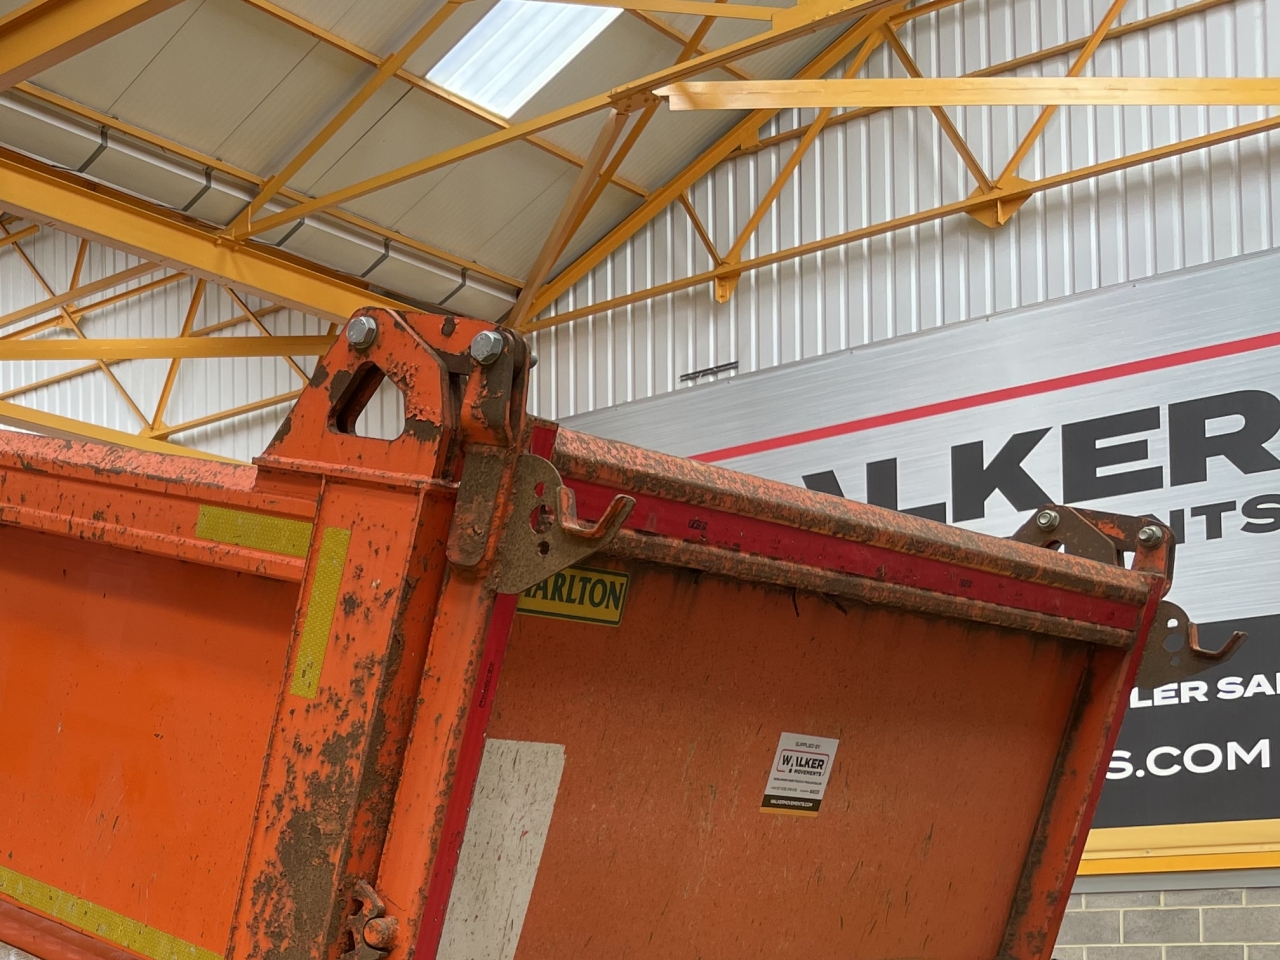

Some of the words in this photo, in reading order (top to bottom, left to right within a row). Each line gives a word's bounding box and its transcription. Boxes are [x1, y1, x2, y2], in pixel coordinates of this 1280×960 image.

[1216, 671, 1280, 700] SA
[794, 768, 822, 777] MOVEMENTS
[1105, 738, 1271, 780] S.COM
